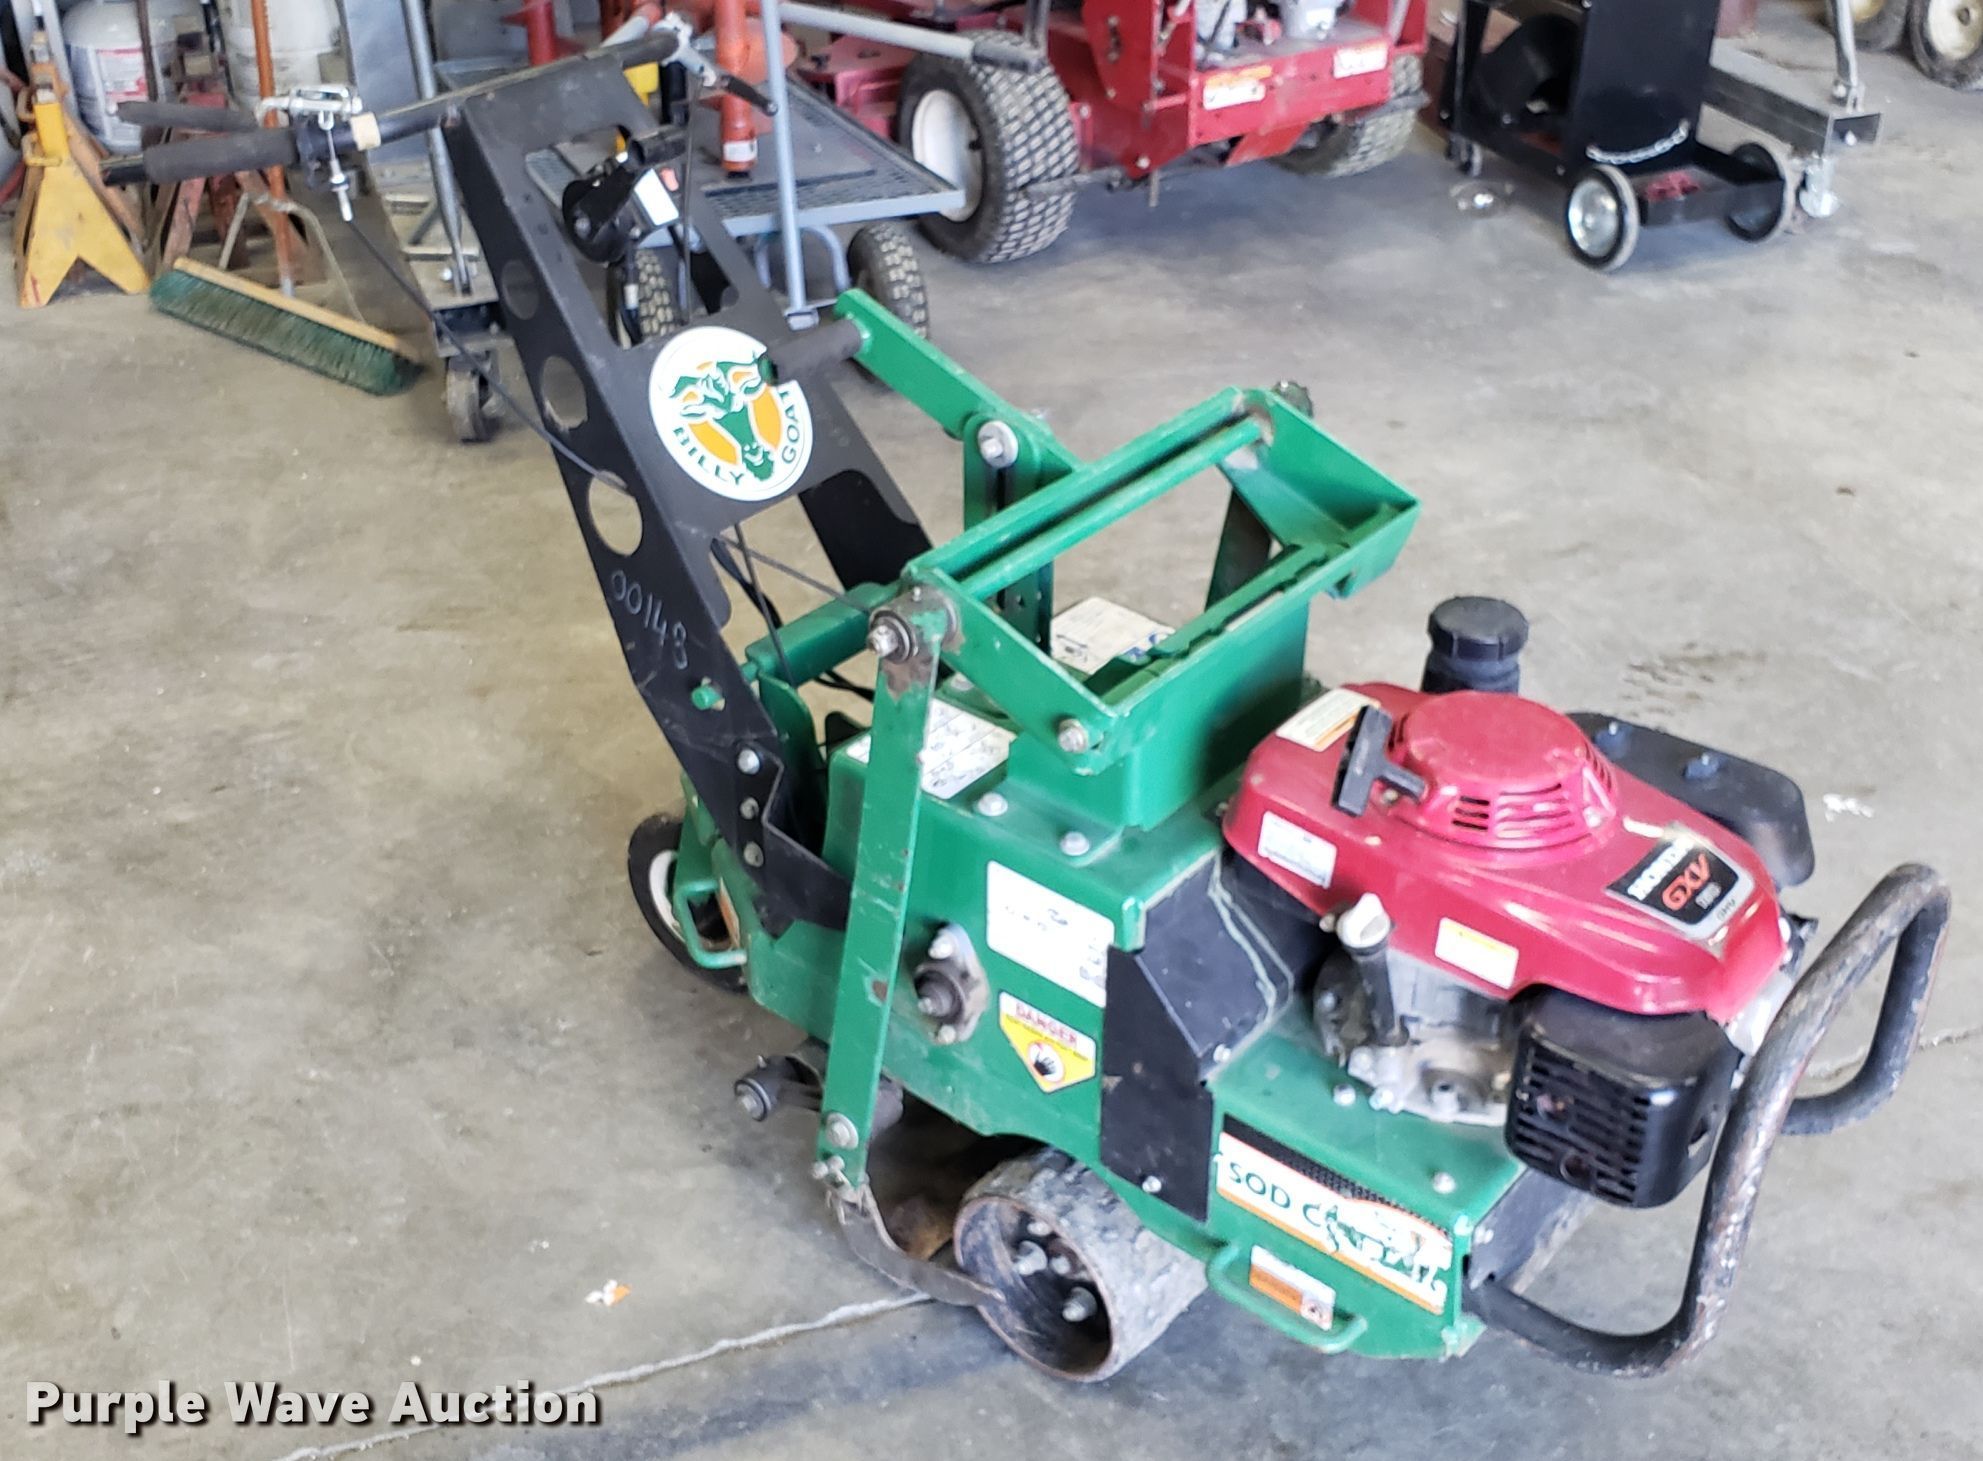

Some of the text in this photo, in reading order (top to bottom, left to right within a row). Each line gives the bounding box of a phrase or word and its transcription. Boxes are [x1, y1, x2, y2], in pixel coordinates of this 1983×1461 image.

[672, 388, 801, 485] BILLY GOAT
[611, 569, 688, 670] 00148
[1662, 852, 1711, 911] GXV
[1015, 1002, 1078, 1047] DANGER
[1229, 1161, 1291, 1209] SOD
